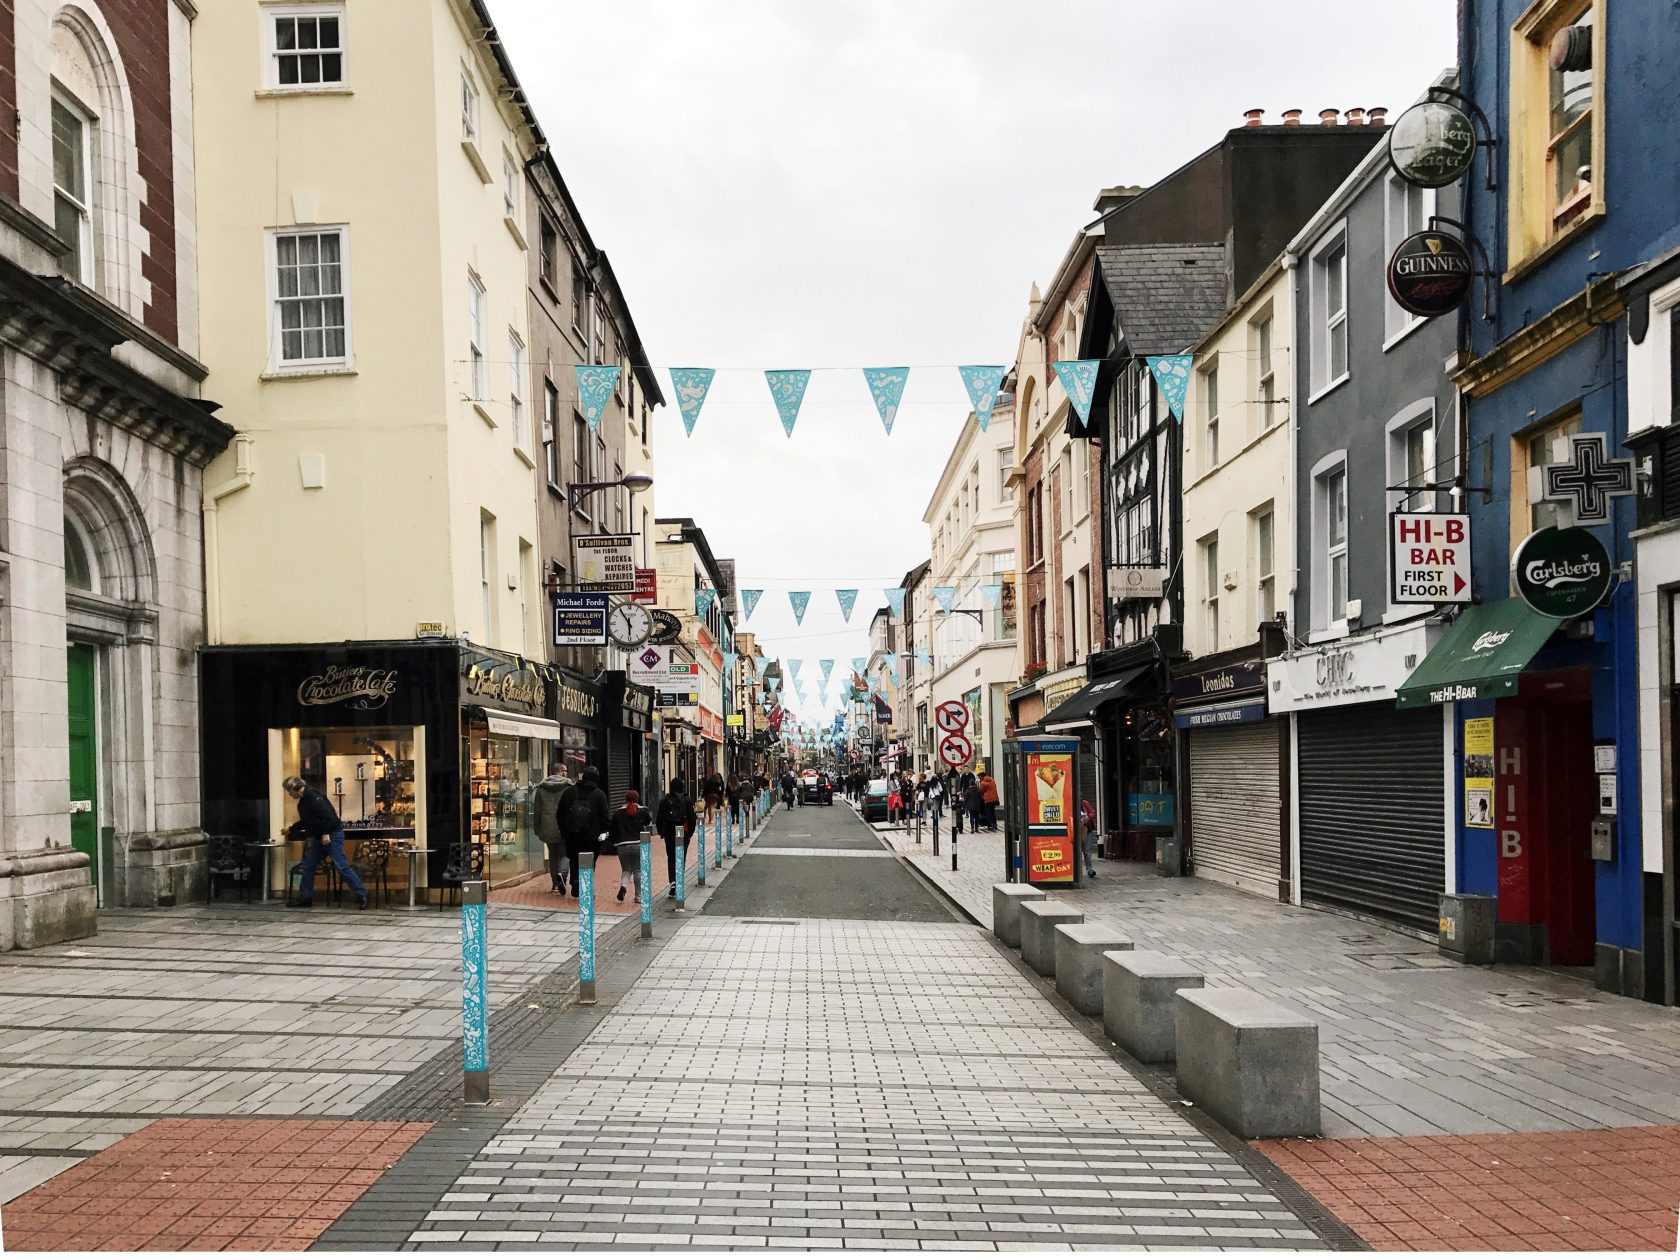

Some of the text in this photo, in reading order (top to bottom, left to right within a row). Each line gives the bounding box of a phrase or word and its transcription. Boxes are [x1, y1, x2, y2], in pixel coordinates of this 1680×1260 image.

[1412, 155, 1462, 174] Lager
[1396, 256, 1469, 275] GUINNESS
[1400, 519, 1465, 544] HI-B
[1410, 548, 1456, 566] BAR
[604, 564, 633, 572] WATCHES
[1404, 570, 1444, 582] FIRST
[1525, 557, 1601, 587] Carlsberg
[1400, 584, 1448, 596] FLOOR
[556, 598, 605, 606] Michael Forde
[324, 665, 364, 683] Butlers
[1316, 651, 1355, 685] CHIC
[297, 676, 365, 705] Chocolate
[1201, 671, 1235, 693] Leonidas
[561, 685, 595, 718] JESSICA'S
[1430, 685, 1477, 703] THE HI-B BAR
[1035, 864, 1054, 872] WRAP
[1056, 863, 1071, 872] DAY
